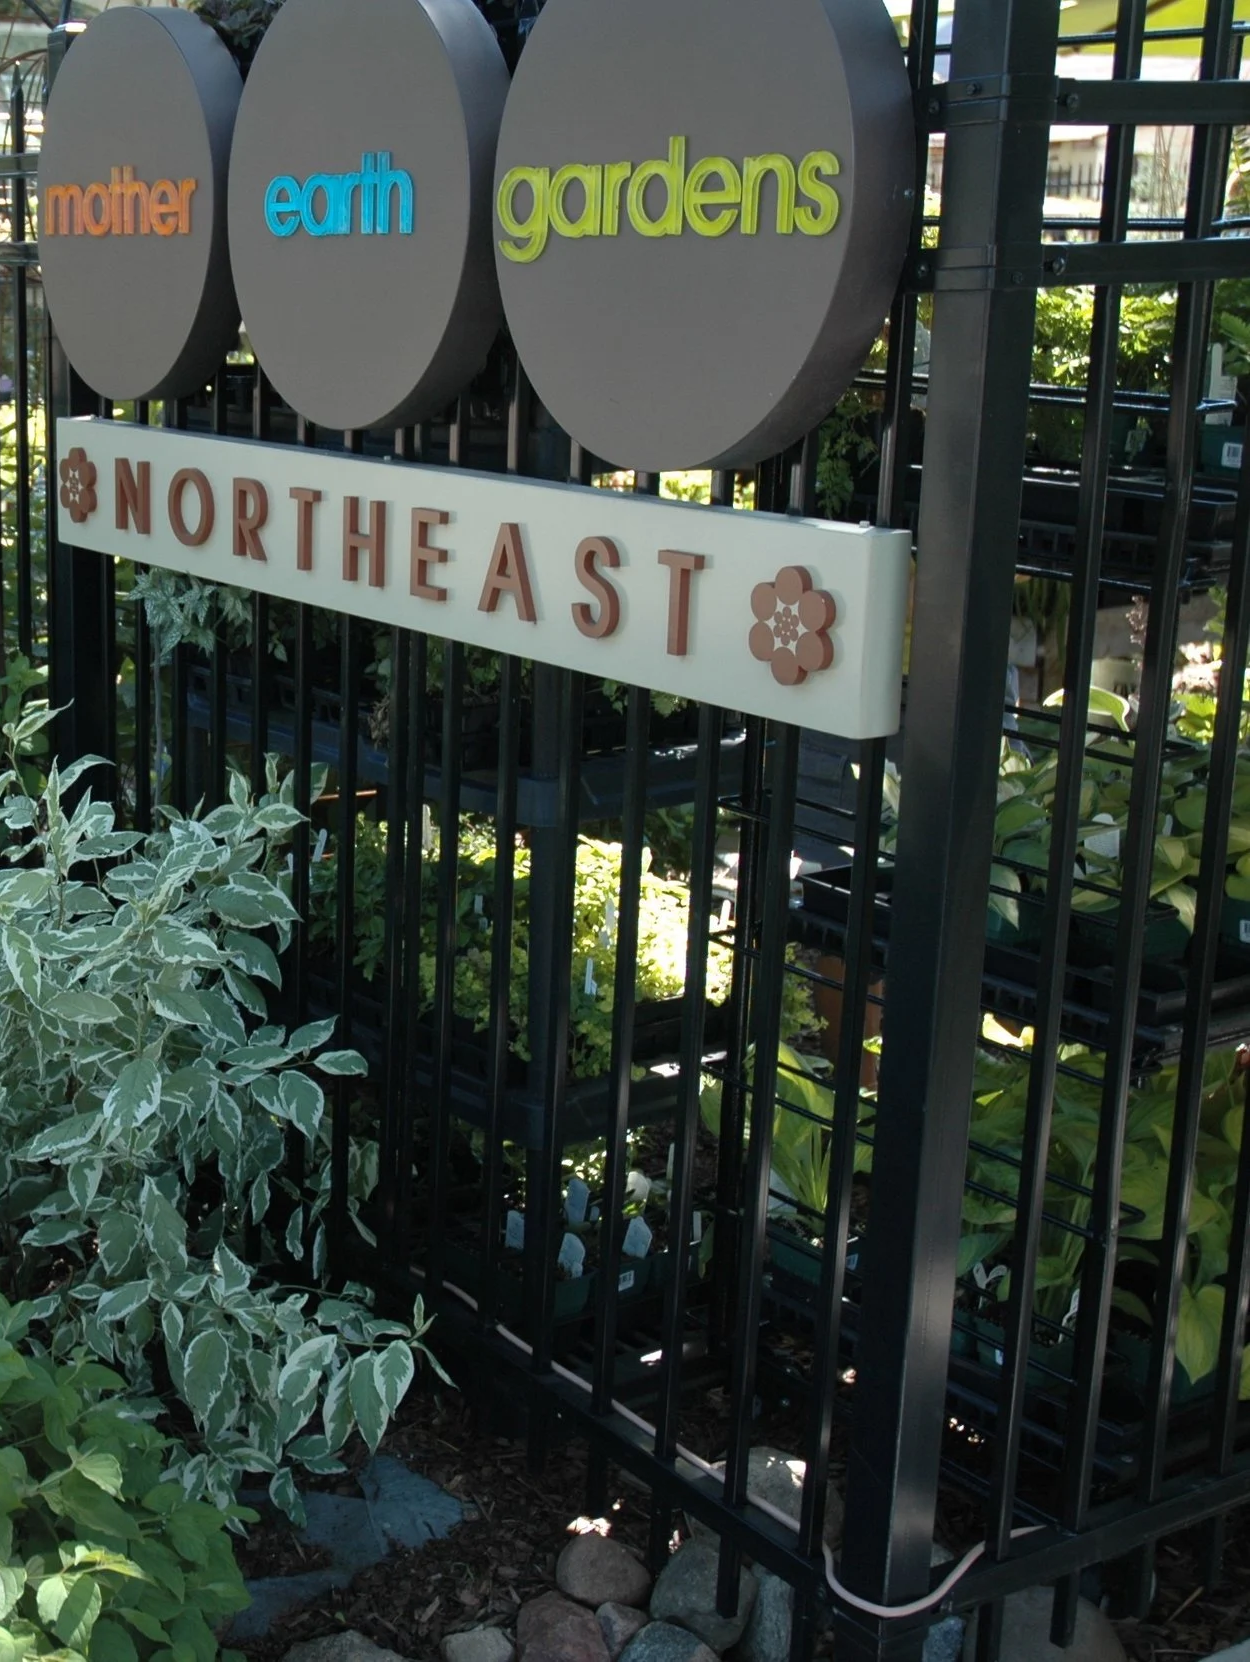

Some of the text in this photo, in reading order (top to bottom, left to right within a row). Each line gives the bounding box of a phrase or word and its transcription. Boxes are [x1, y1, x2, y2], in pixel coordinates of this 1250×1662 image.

[45, 135, 841, 263] mother earth gardens
[114, 457, 706, 657] NORTHEAST
